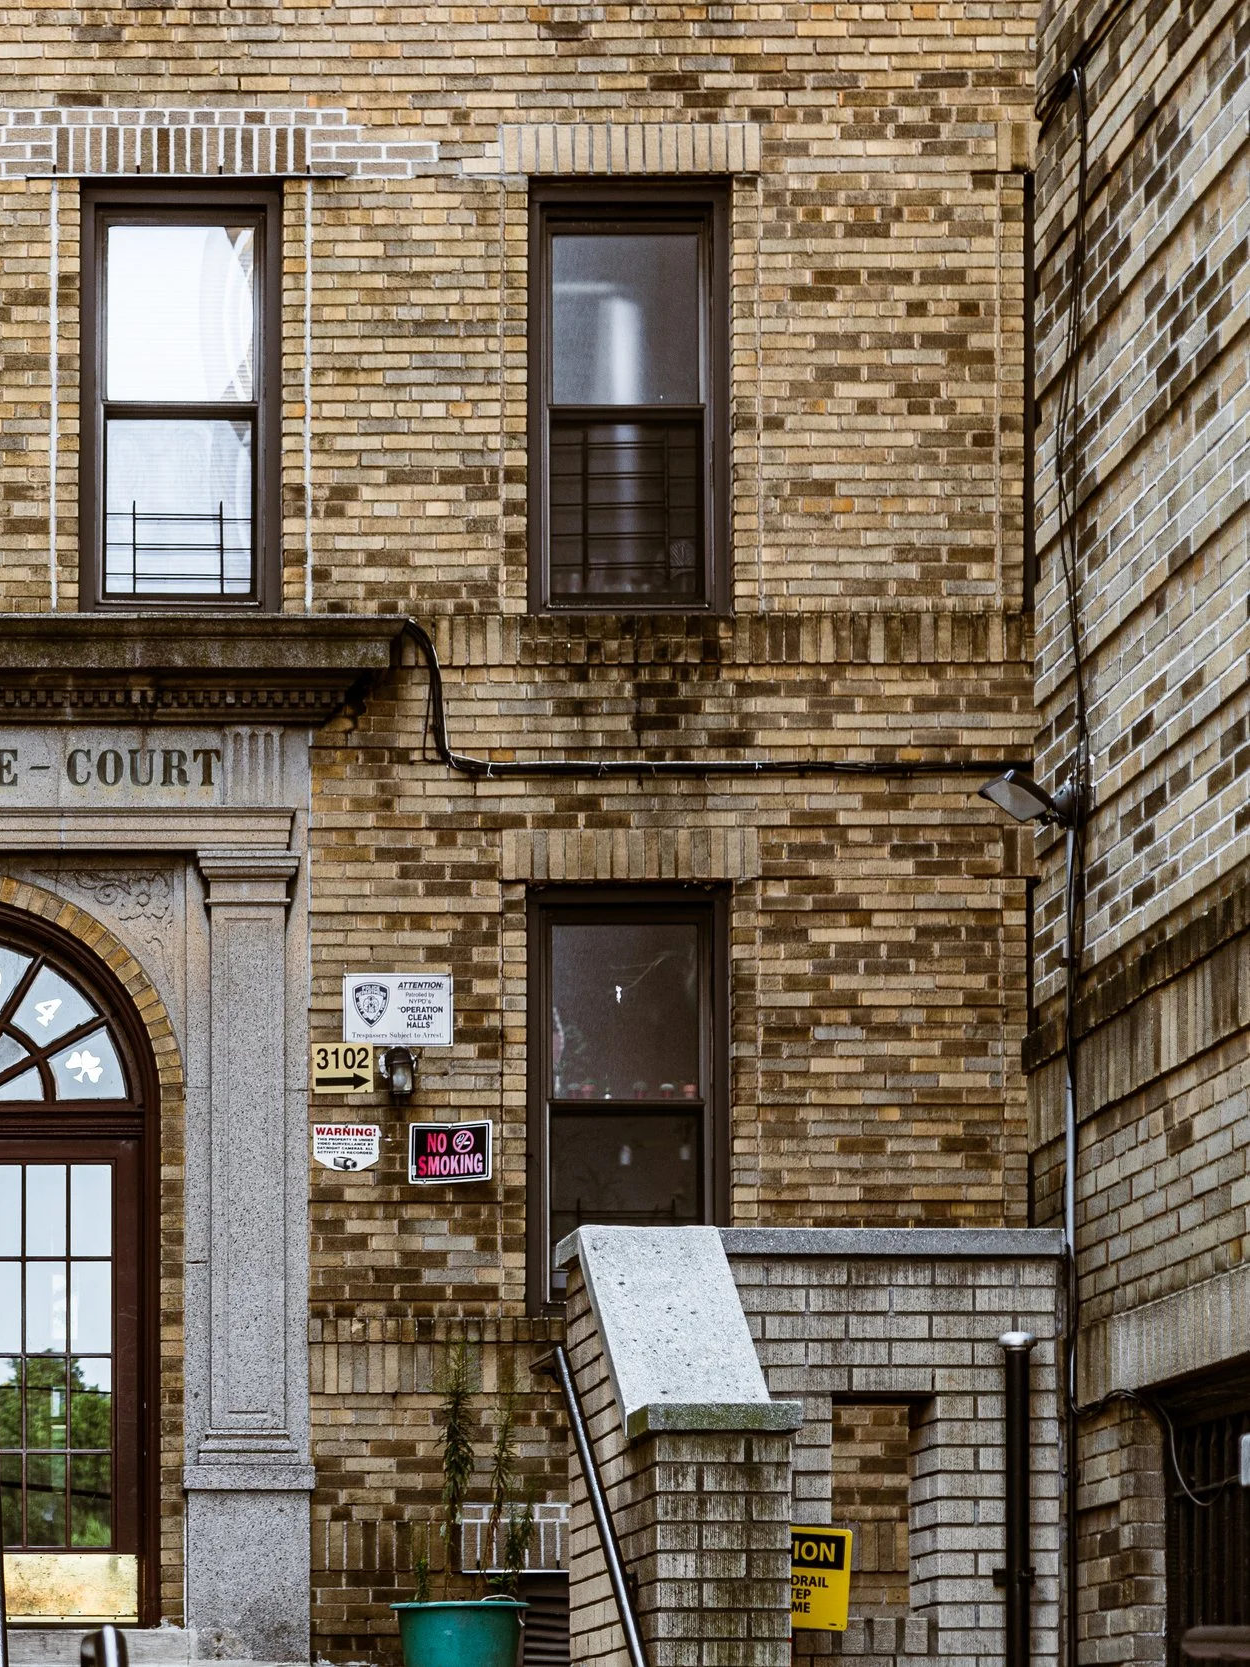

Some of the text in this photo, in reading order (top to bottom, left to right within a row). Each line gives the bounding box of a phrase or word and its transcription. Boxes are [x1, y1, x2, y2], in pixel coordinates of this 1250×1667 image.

[66, 748, 223, 788] COURT
[397, 981, 444, 989] ATTENTION:
[352, 1032, 388, 1040] Trespassers
[390, 1032, 412, 1040] Subject
[316, 1047, 370, 1070] 3102
[315, 1127, 377, 1137] WARNING!
[427, 1132, 448, 1154] NO
[418, 1152, 484, 1176] SMOKING
[791, 1540, 836, 1562] ION
